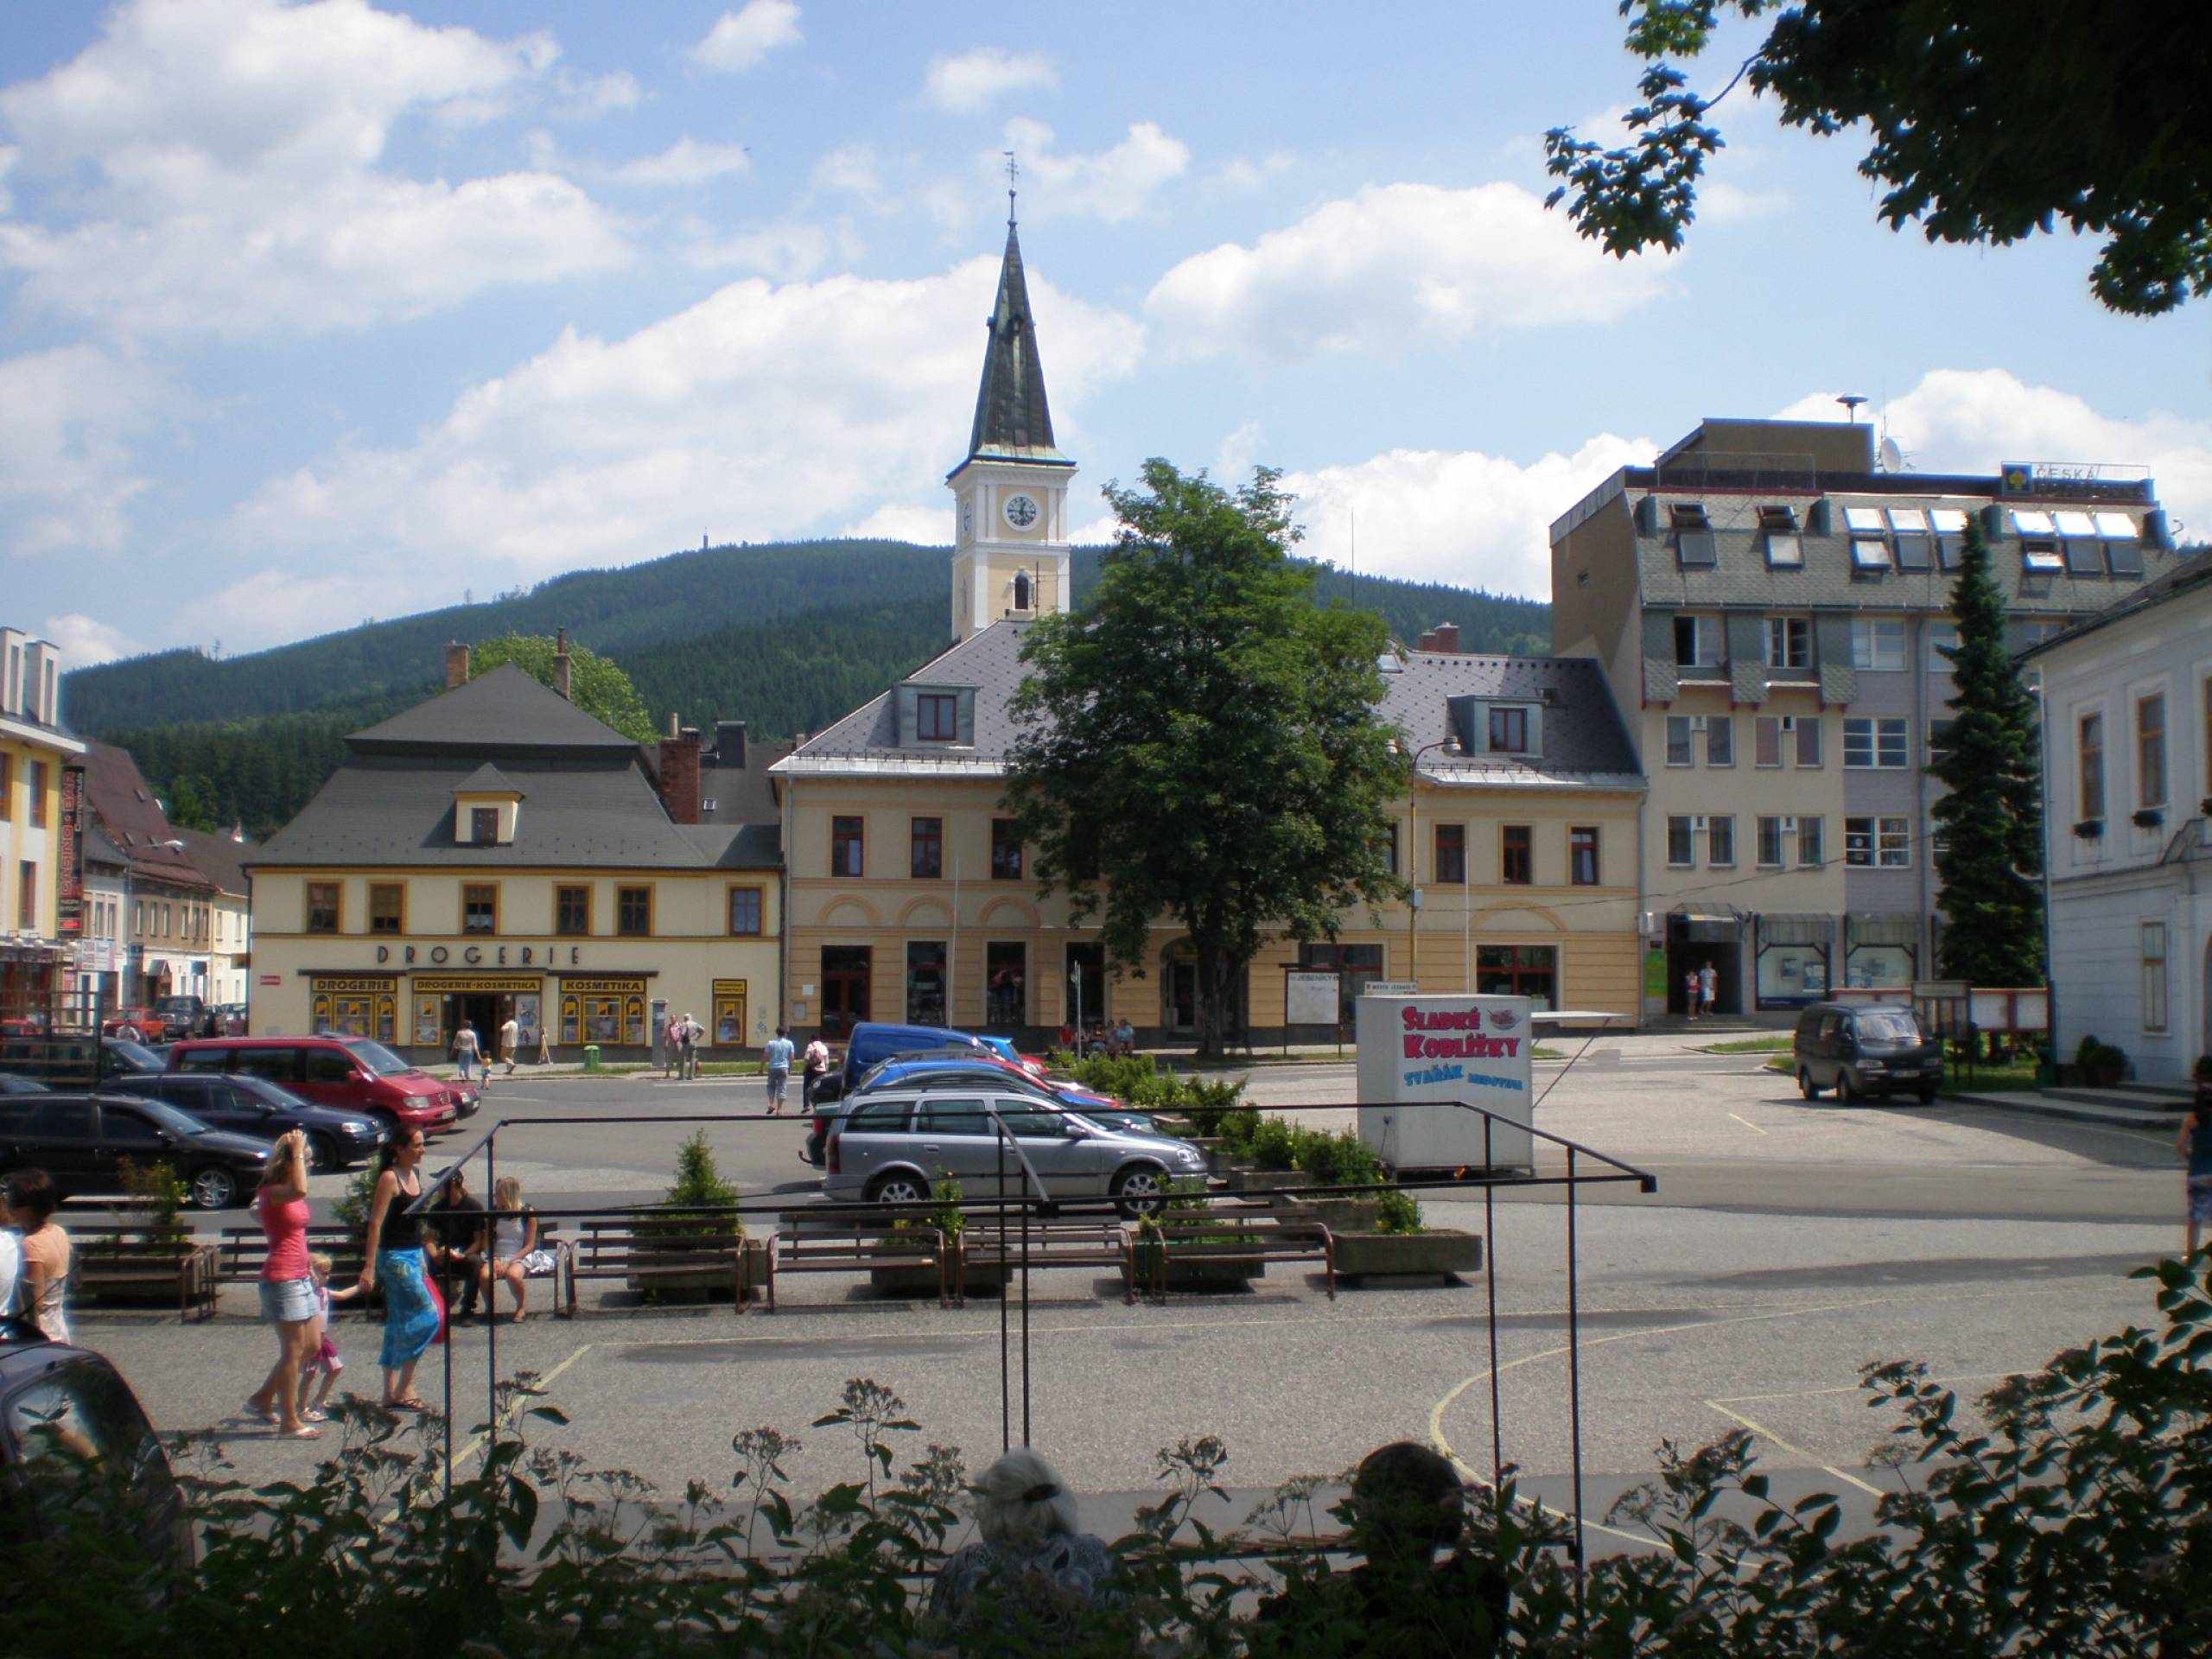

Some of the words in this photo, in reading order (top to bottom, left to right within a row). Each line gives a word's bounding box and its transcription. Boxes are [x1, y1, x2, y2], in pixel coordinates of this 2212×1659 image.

[62, 772, 75, 812] BAR
[60, 824, 74, 896] CASINO
[377, 945, 579, 964] DROGERIE
[317, 980, 391, 990] DROGERIE
[566, 981, 640, 990] KOSMETIKA
